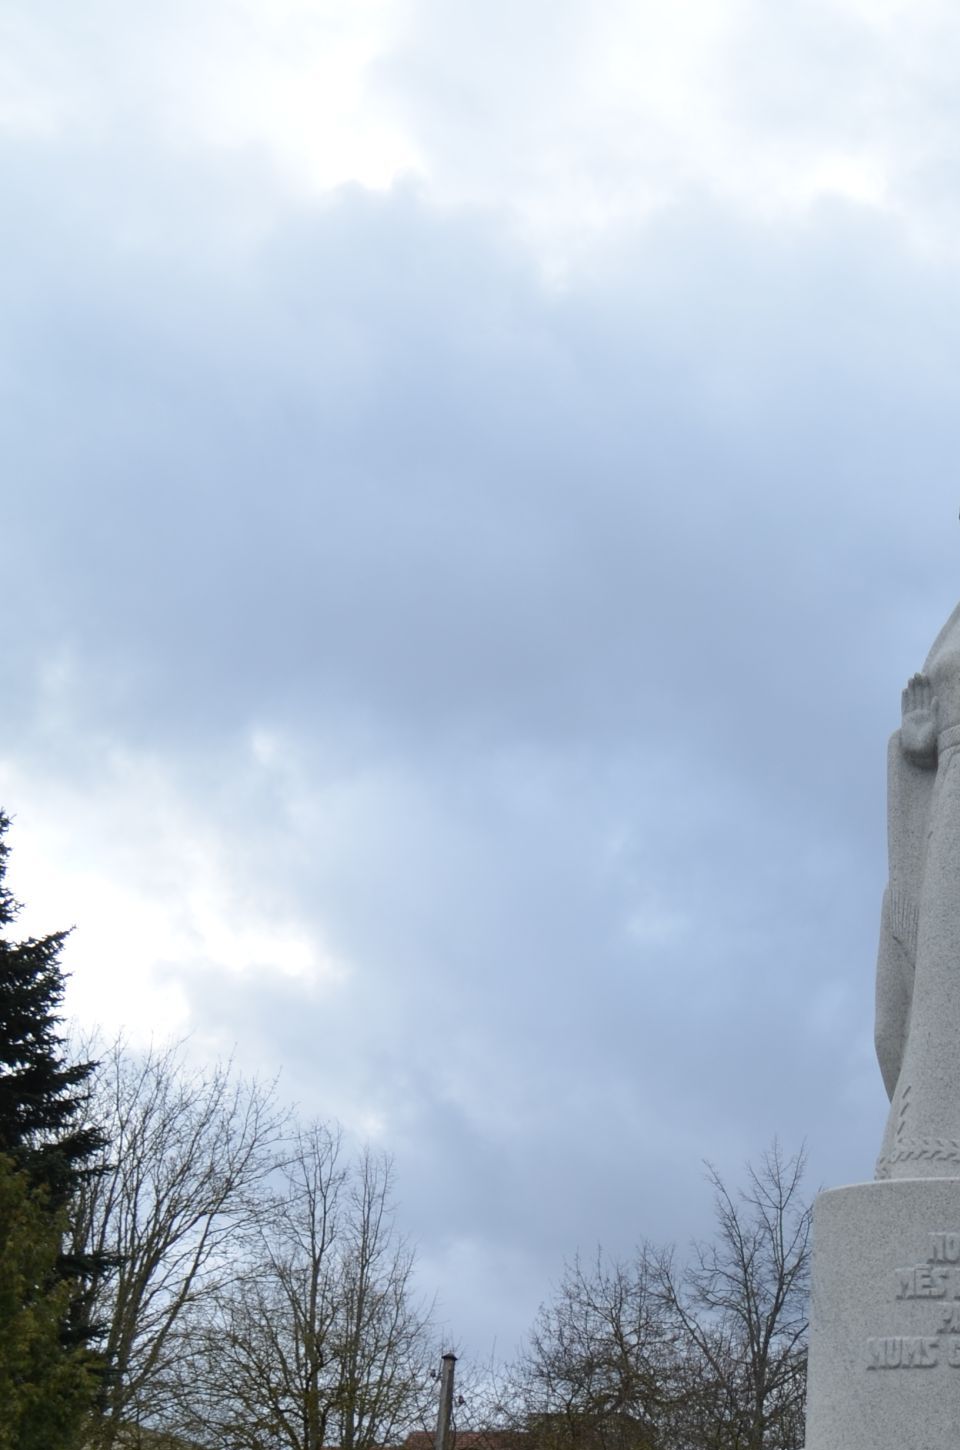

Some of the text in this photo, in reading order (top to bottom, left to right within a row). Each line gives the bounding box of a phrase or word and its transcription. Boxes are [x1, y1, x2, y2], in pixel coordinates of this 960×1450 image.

[927, 1231, 960, 1264] NO
[896, 1264, 948, 1300] MĒS
[866, 1336, 938, 1371] MUMS
